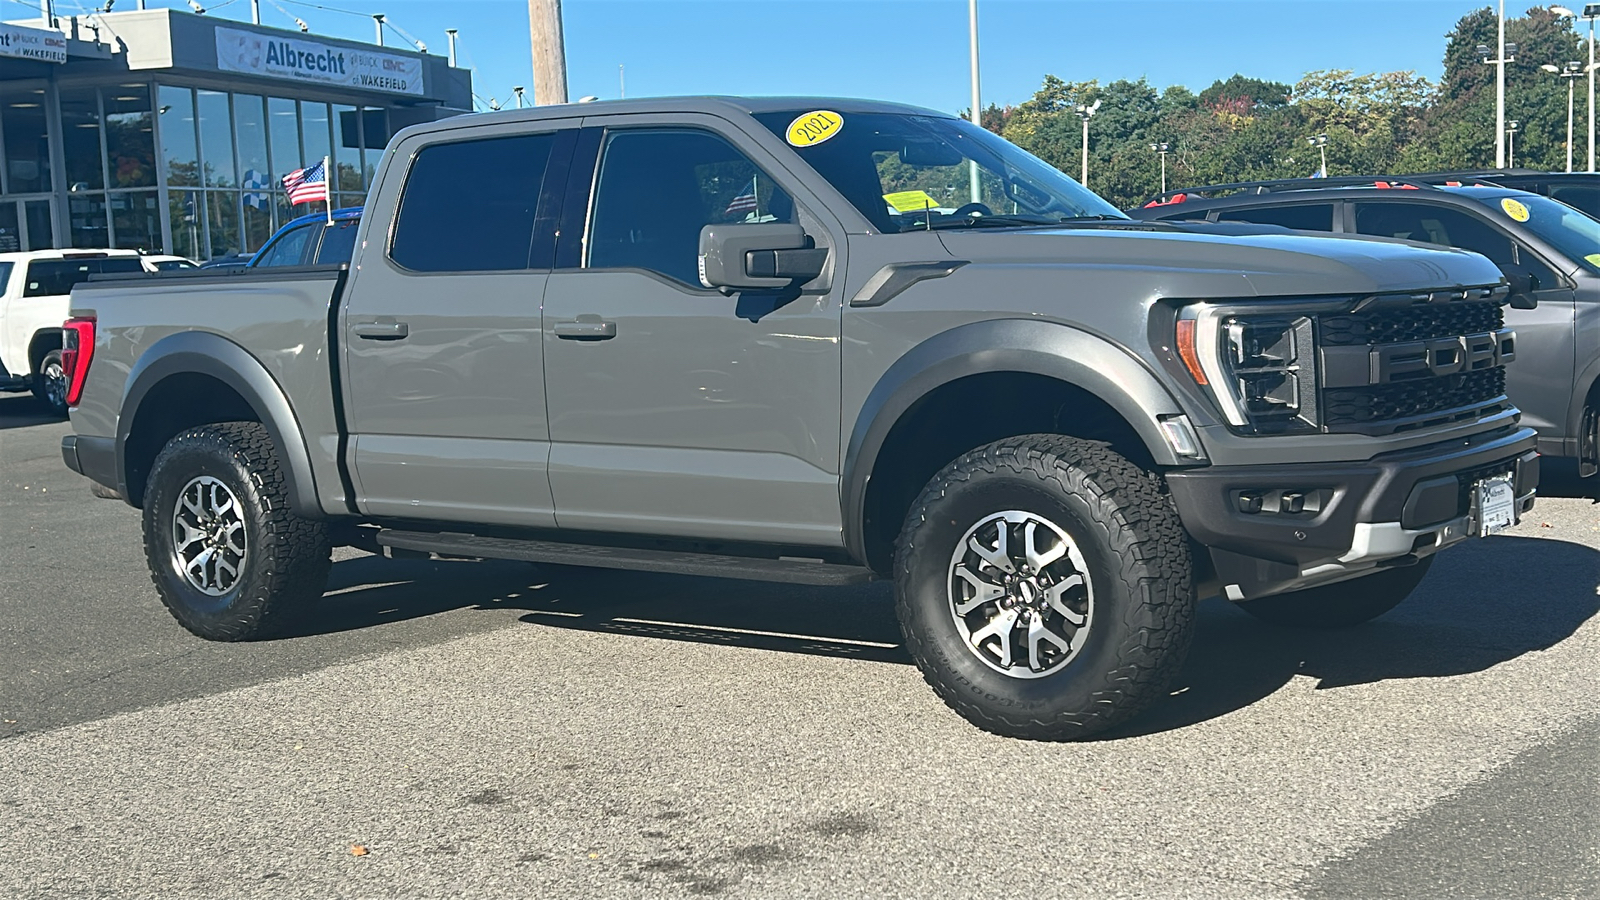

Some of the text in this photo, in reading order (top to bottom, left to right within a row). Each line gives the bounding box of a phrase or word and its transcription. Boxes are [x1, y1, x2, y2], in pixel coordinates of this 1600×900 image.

[22, 48, 65, 60] WAKEFIELD
[266, 41, 345, 74] Albrecht
[383, 59, 406, 73] GMC
[360, 74, 407, 91] WAKEFIELD
[797, 114, 836, 141] 2021
[1369, 328, 1517, 385] FORD
